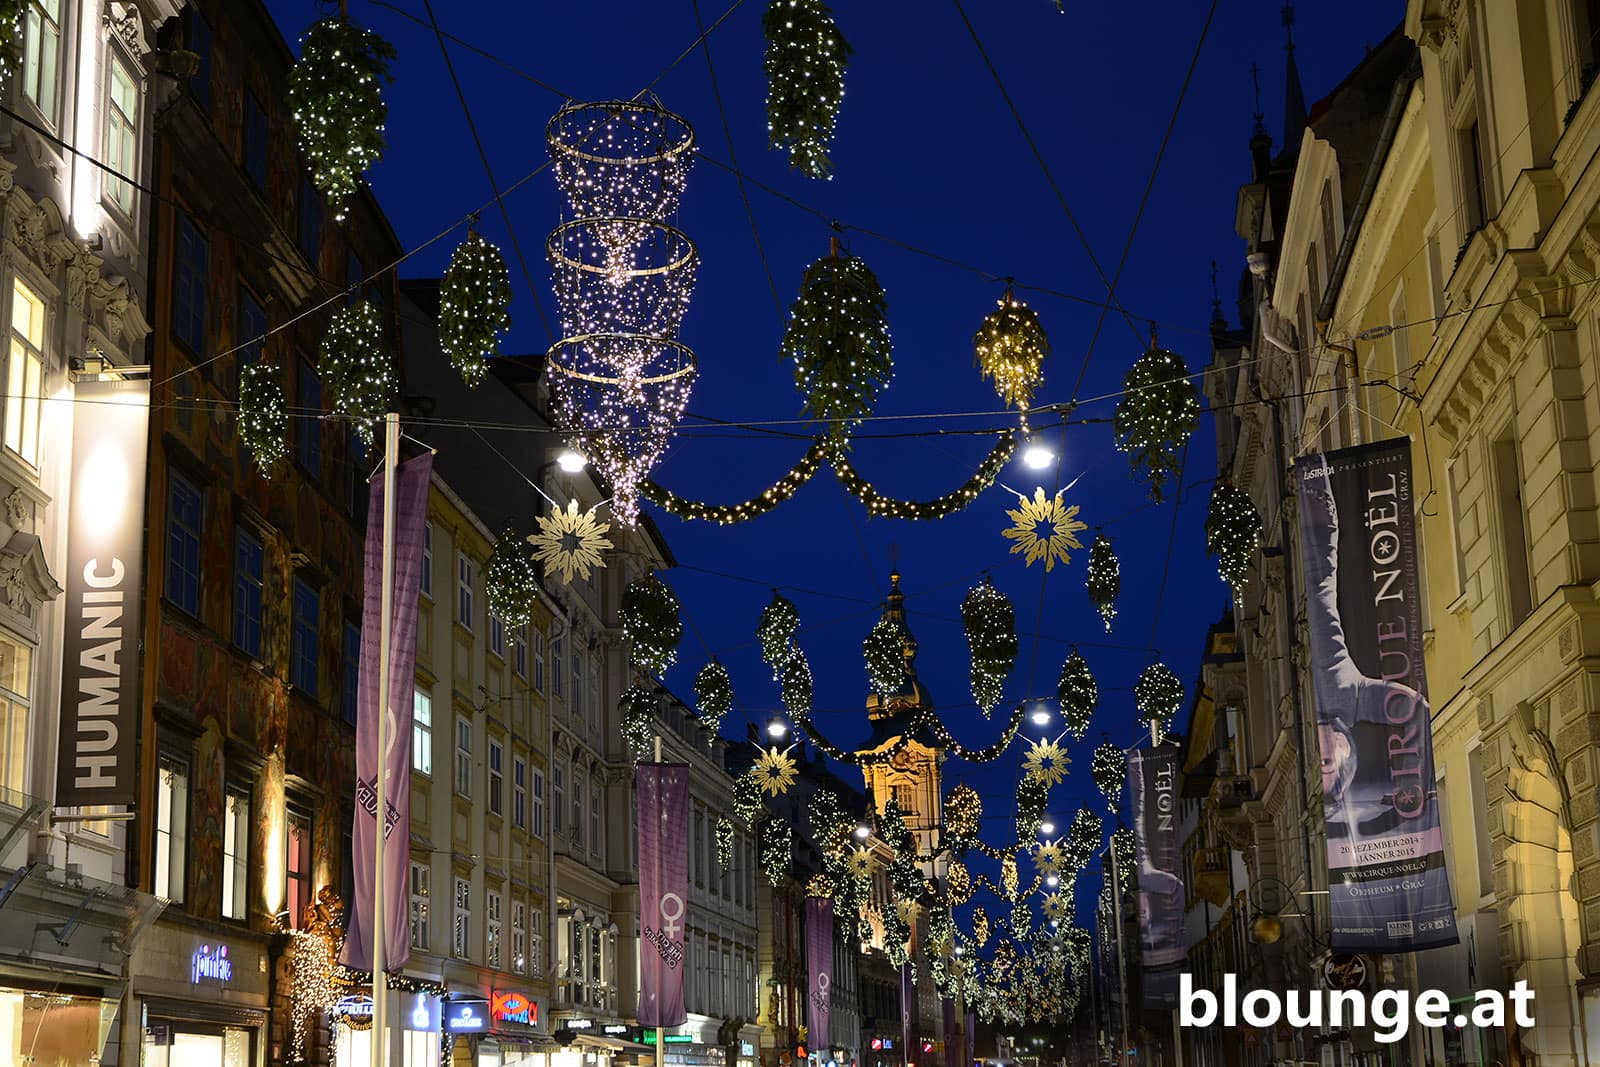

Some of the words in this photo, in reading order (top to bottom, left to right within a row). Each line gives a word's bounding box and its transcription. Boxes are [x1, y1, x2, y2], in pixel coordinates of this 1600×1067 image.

[1400, 469, 1409, 501] GRAZ
[1364, 473, 1404, 606] NOËL
[75, 558, 125, 788] HUMANIC
[1377, 616, 1424, 818] CIRQUE
[1155, 763, 1174, 831] NOËL
[1397, 848, 1415, 857] 2015
[1400, 837, 1419, 846] 2014
